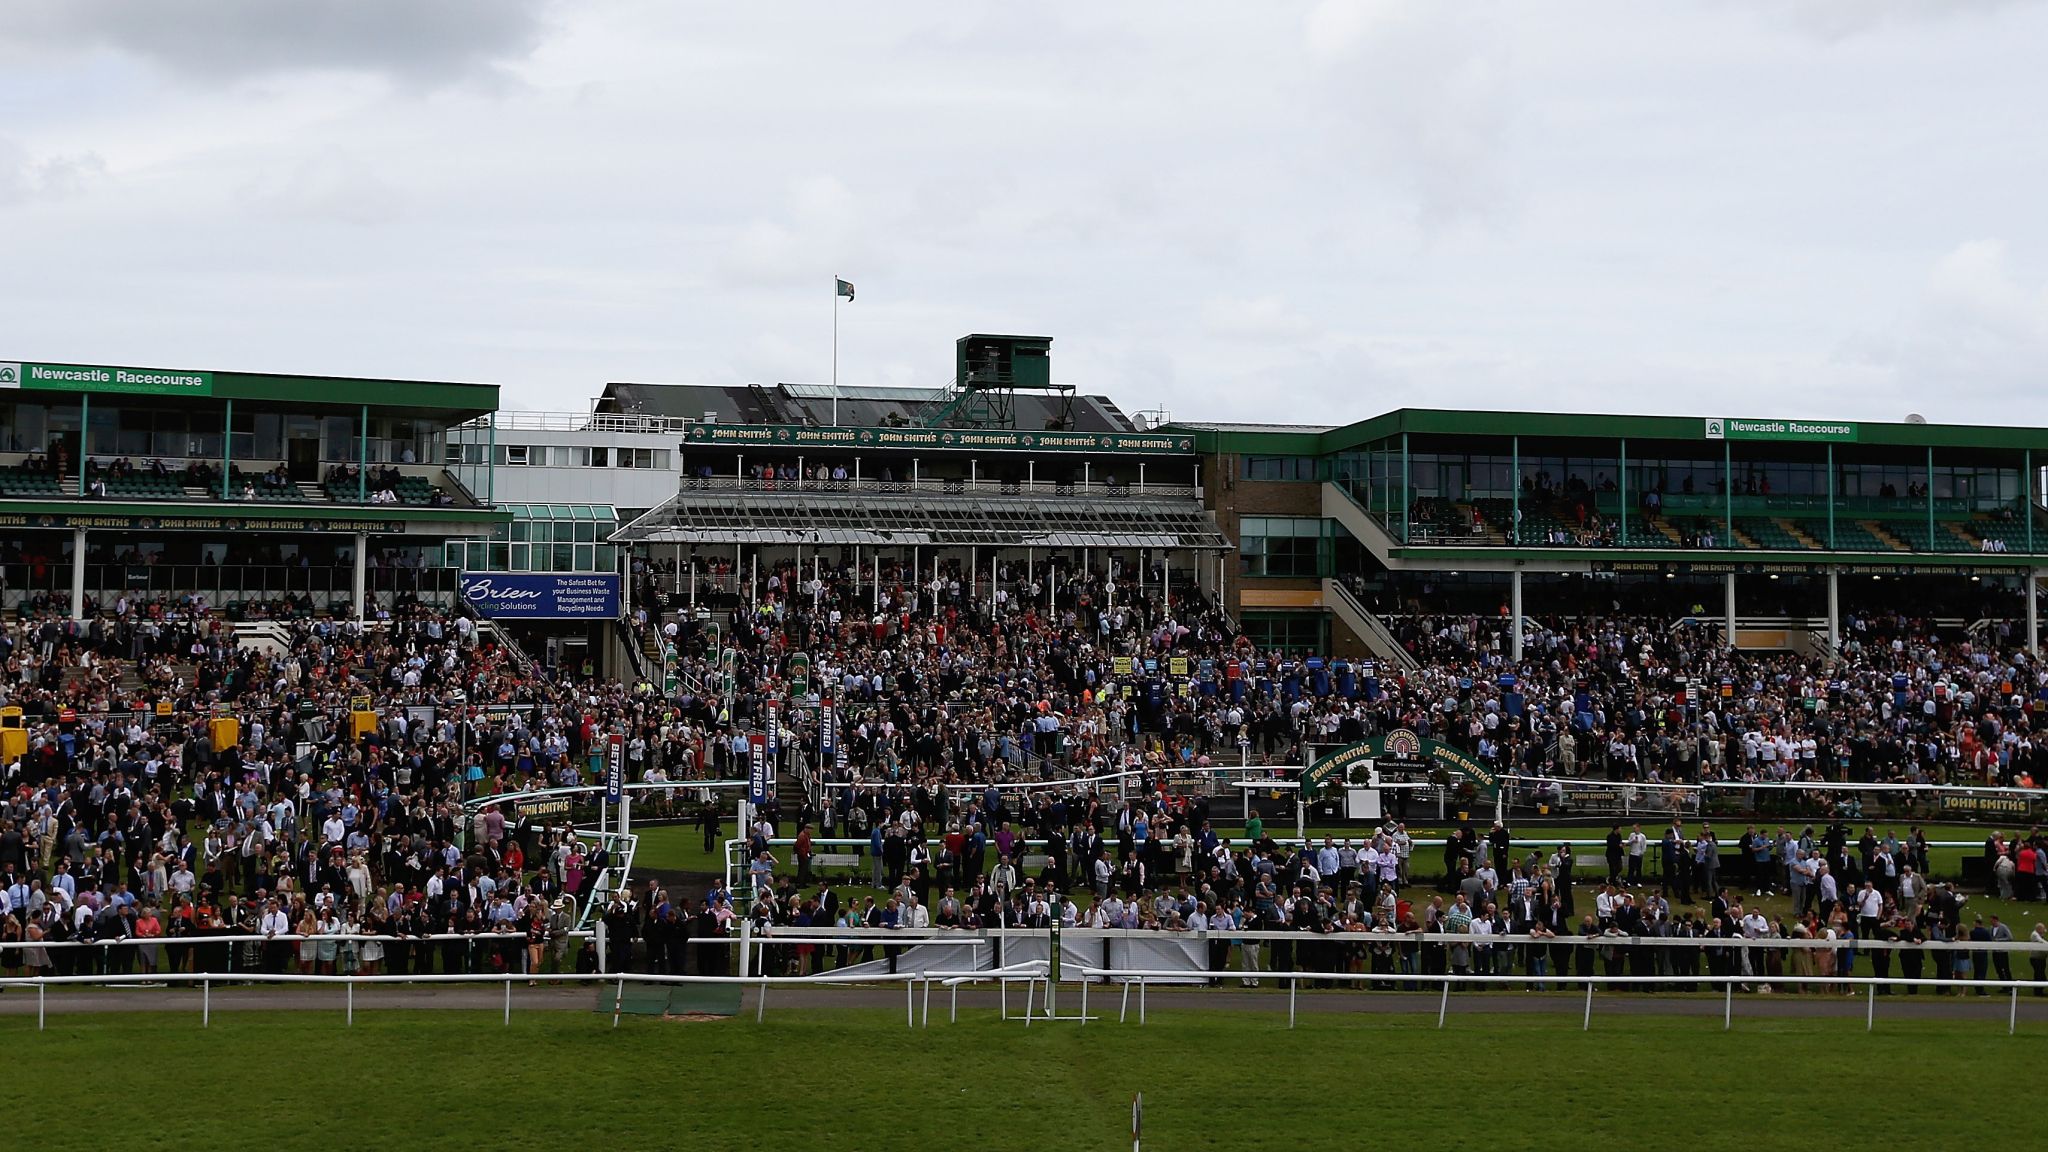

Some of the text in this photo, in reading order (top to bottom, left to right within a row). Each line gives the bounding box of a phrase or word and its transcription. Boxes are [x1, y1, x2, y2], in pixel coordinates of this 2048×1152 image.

[31, 366, 202, 386] Newcastle Racecourse
[712, 427, 772, 439] JOHN SMITH'S
[1730, 421, 1850, 434] Newcastle Racecourse
[796, 429, 855, 440] JOHN SMITH'S
[879, 431, 936, 443] JOHN SMITH'S
[960, 433, 1017, 444] JOHN SMITH'S
[1040, 435, 1095, 446] JOHN SMITH'S
[1118, 437, 1172, 449] JOHN SMITH'S
[65, 517, 92, 527] JOHN
[159, 519, 185, 528] JOHN
[245, 520, 270, 529] JOHN
[327, 521, 352, 530] JOHN
[461, 579, 542, 600] Brien
[566, 587, 591, 595] Business
[557, 596, 593, 604] Management
[500, 602, 537, 610] Solutions
[557, 604, 585, 613] Recycling
[768, 706, 776, 749] BETFRED
[1310, 742, 1370, 782] JOHN SMITH'S
[1433, 746, 1493, 786] JOHN SMITH'S
[611, 743, 620, 796] BETFRED
[753, 743, 763, 797] BETFRED
[1571, 792, 1589, 800] JOHN
[1944, 797, 2026, 811] JOHN SMITH'S
